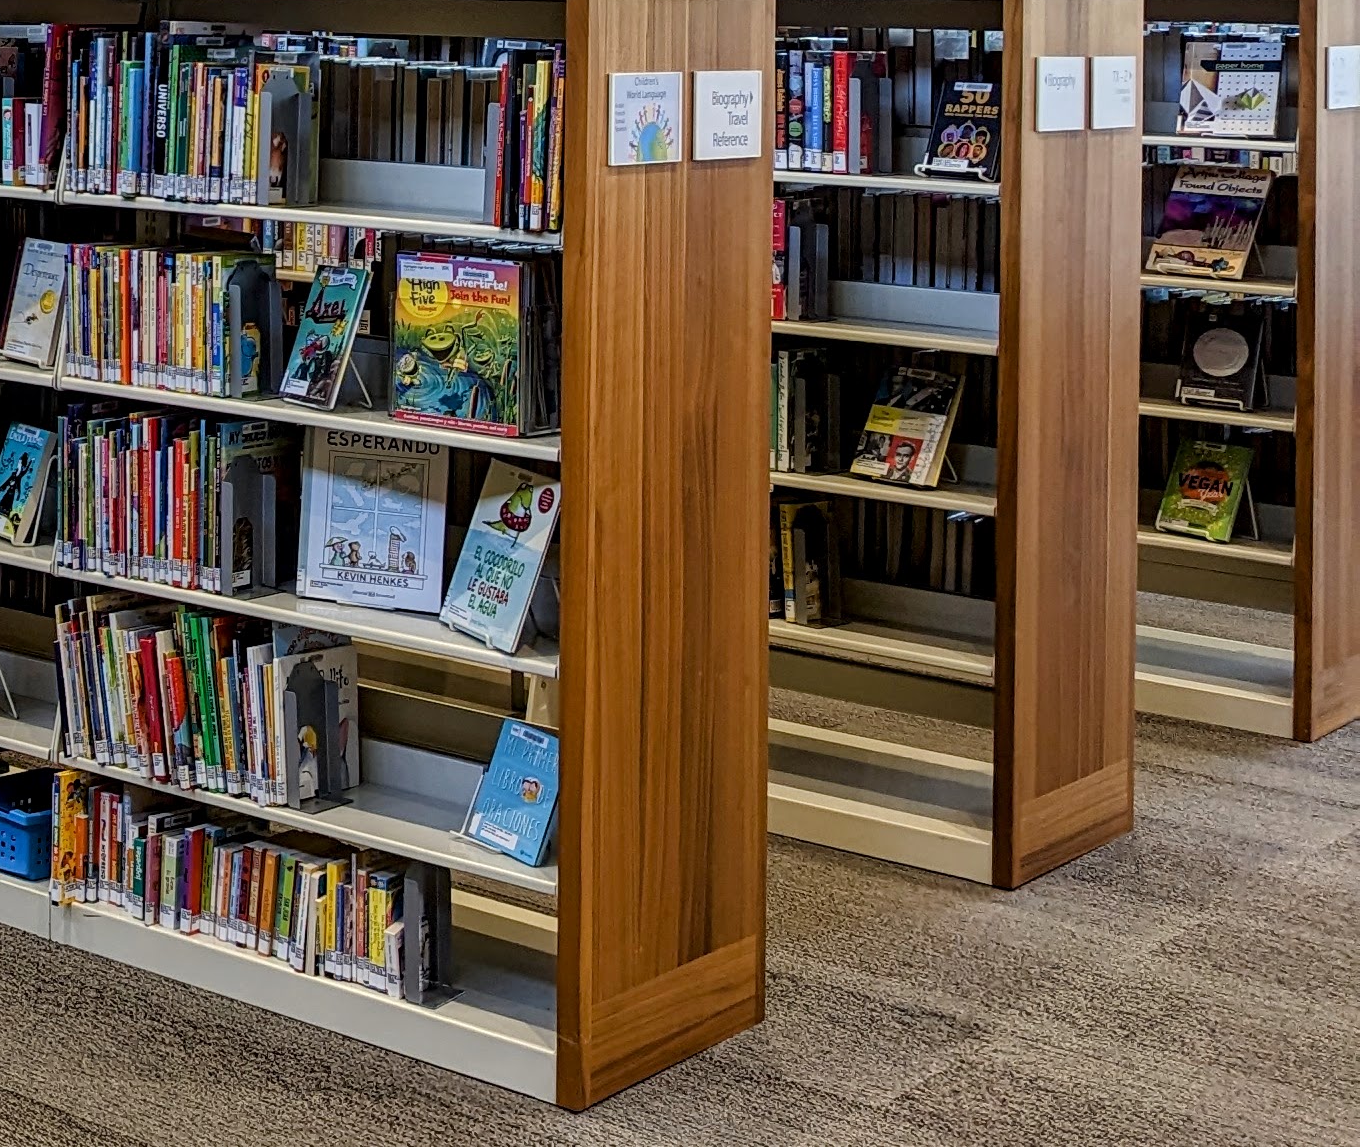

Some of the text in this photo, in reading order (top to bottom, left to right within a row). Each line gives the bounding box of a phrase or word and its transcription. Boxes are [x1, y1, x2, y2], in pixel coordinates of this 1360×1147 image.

[1215, 62, 1239, 71] paper
[634, 77, 659, 86] Children's
[1046, 73, 1077, 91] Biography
[626, 90, 667, 101] World Language
[711, 90, 749, 109] Biography
[156, 83, 169, 139] UNIVERSO
[727, 110, 749, 126] Travel
[944, 103, 1000, 116] RAPPERS
[712, 132, 749, 148] Reference
[1179, 179, 1263, 195] Found Objects
[452, 275, 508, 292] divertirte!
[409, 289, 511, 307] Five Join the Fun!
[326, 430, 441, 455] ESPERANDO
[1178, 472, 1234, 497] VEGAN
[474, 545, 526, 578] EL COCODRILO
[336, 570, 410, 589] KEVIN HENKES
[474, 563, 514, 589] AL QUE NO
[466, 577, 511, 607] LE GUSTABA
[466, 593, 499, 620] EL AGUA
[491, 766, 552, 810] LIBRO DE
[481, 797, 541, 843] ORACIONES
